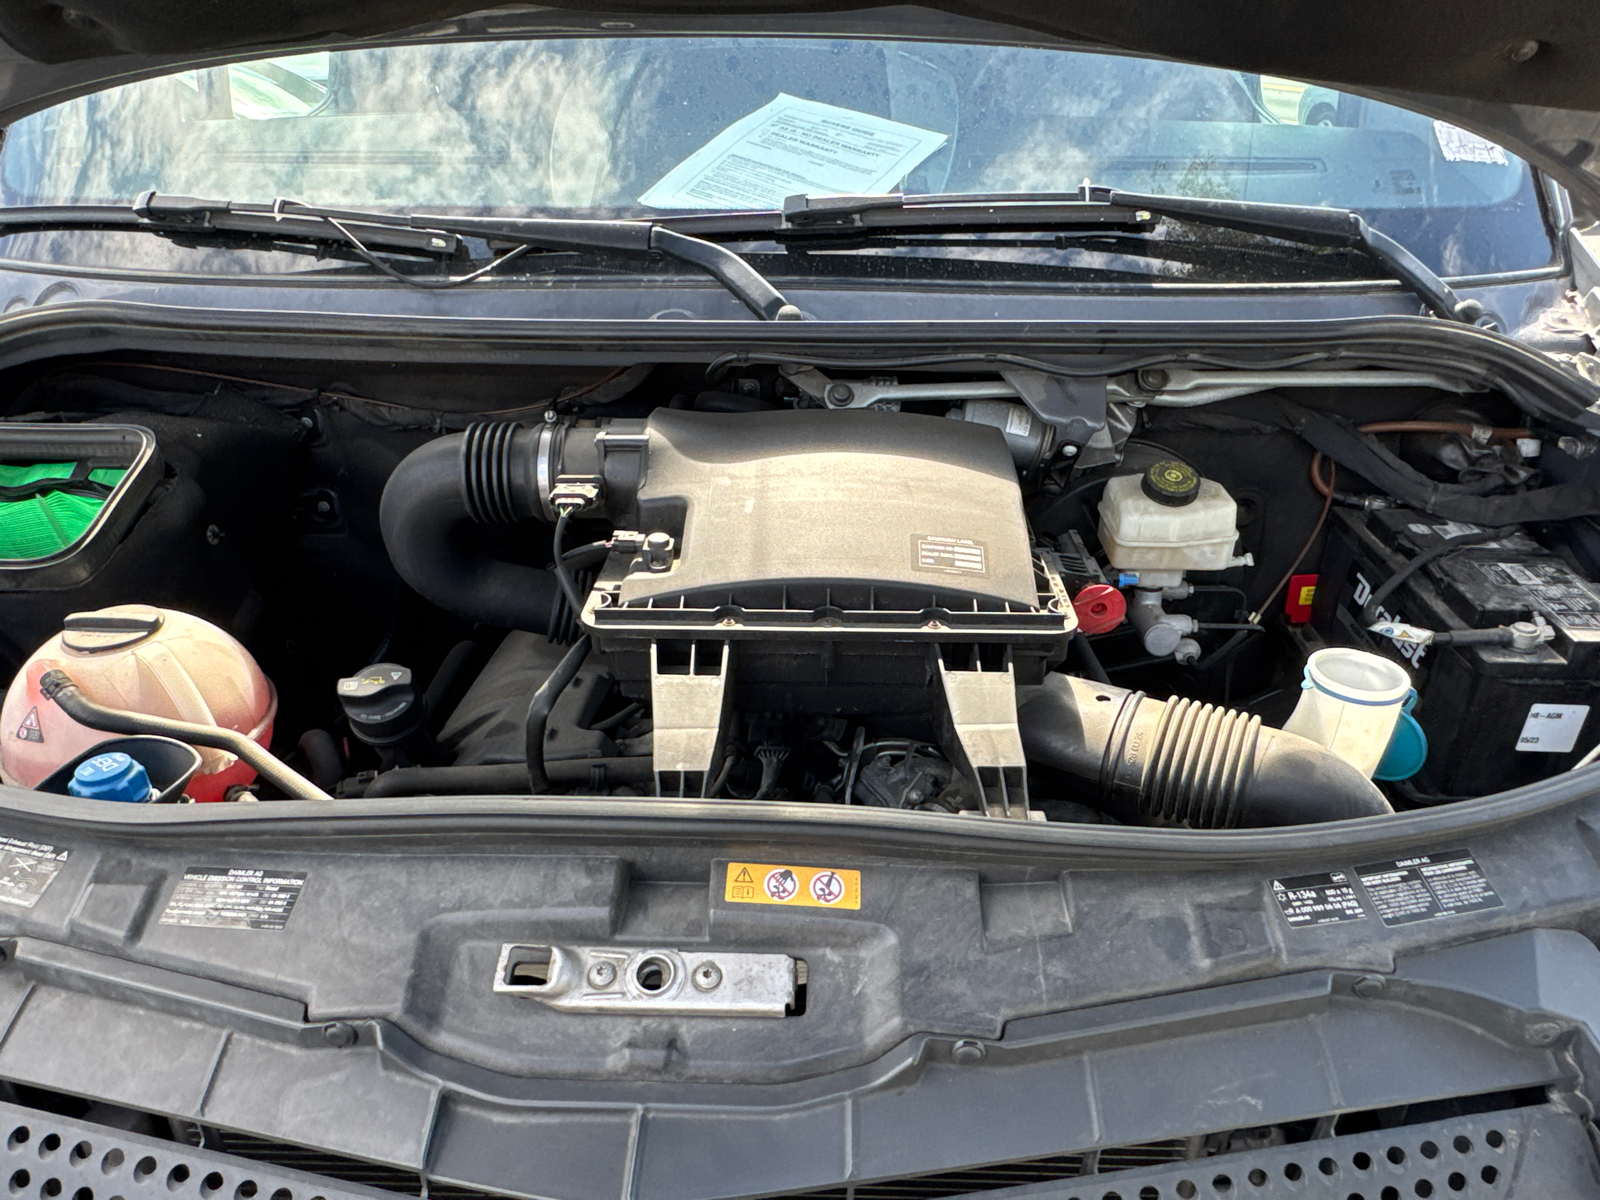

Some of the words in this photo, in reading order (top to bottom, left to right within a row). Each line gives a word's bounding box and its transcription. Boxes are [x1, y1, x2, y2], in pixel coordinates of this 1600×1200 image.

[821, 120, 851, 130] BUYERS
[852, 127, 876, 136] GUIDE
[771, 132, 799, 142] DEALER
[799, 140, 838, 154] WARRANTY
[813, 135, 840, 146] DEALER
[841, 144, 881, 158] WARRANTY
[235, 876, 262, 884] CONTROL
[263, 877, 304, 885] INFORMATION
[1287, 890, 1317, 900] R-134a
